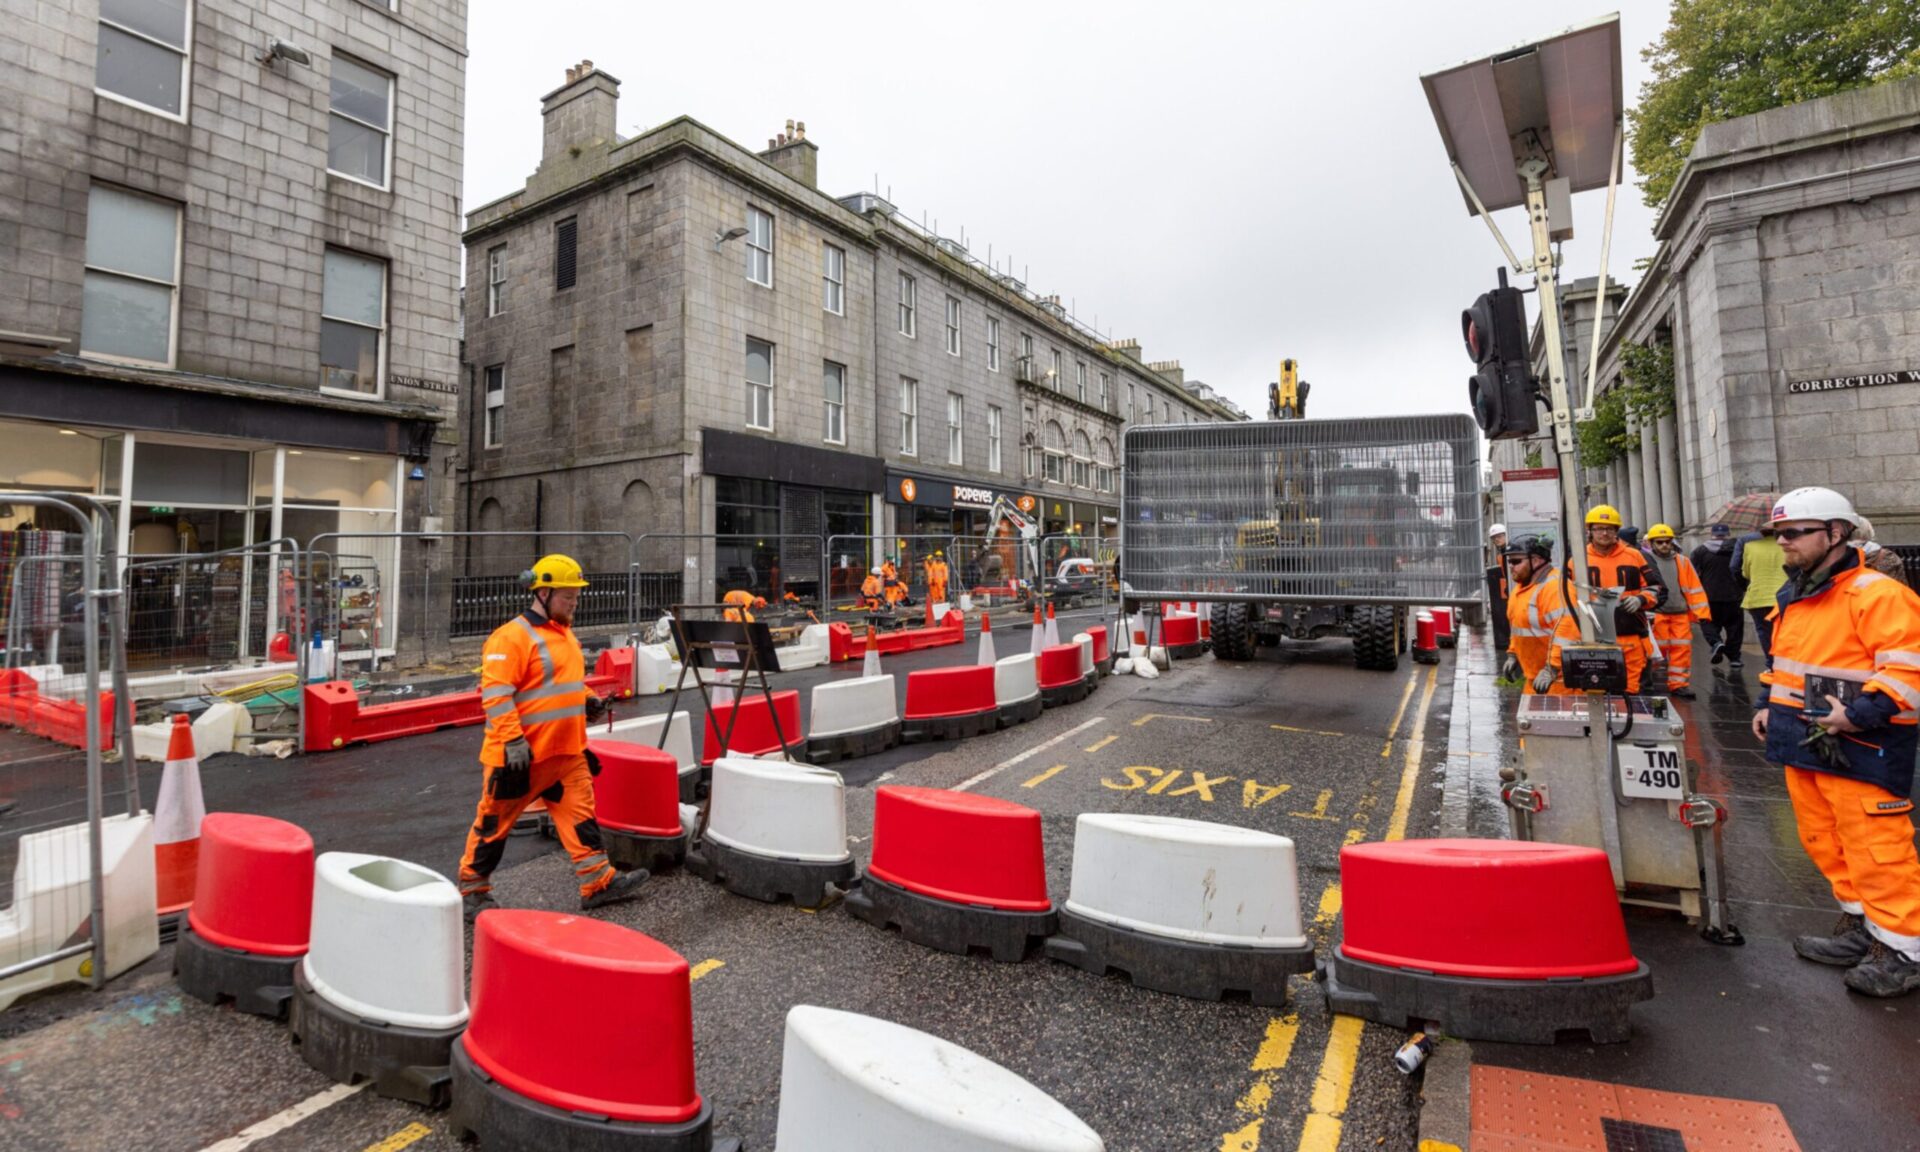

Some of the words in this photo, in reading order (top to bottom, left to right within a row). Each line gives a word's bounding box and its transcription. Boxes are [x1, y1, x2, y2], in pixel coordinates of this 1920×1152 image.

[390, 375, 420, 387] UNION
[423, 381, 459, 394] STREET
[1790, 372, 1899, 393] CORRECTION
[1643, 750, 1679, 769] TM
[1639, 769, 1681, 789] 490
[1100, 765, 1341, 823] TAXIS
